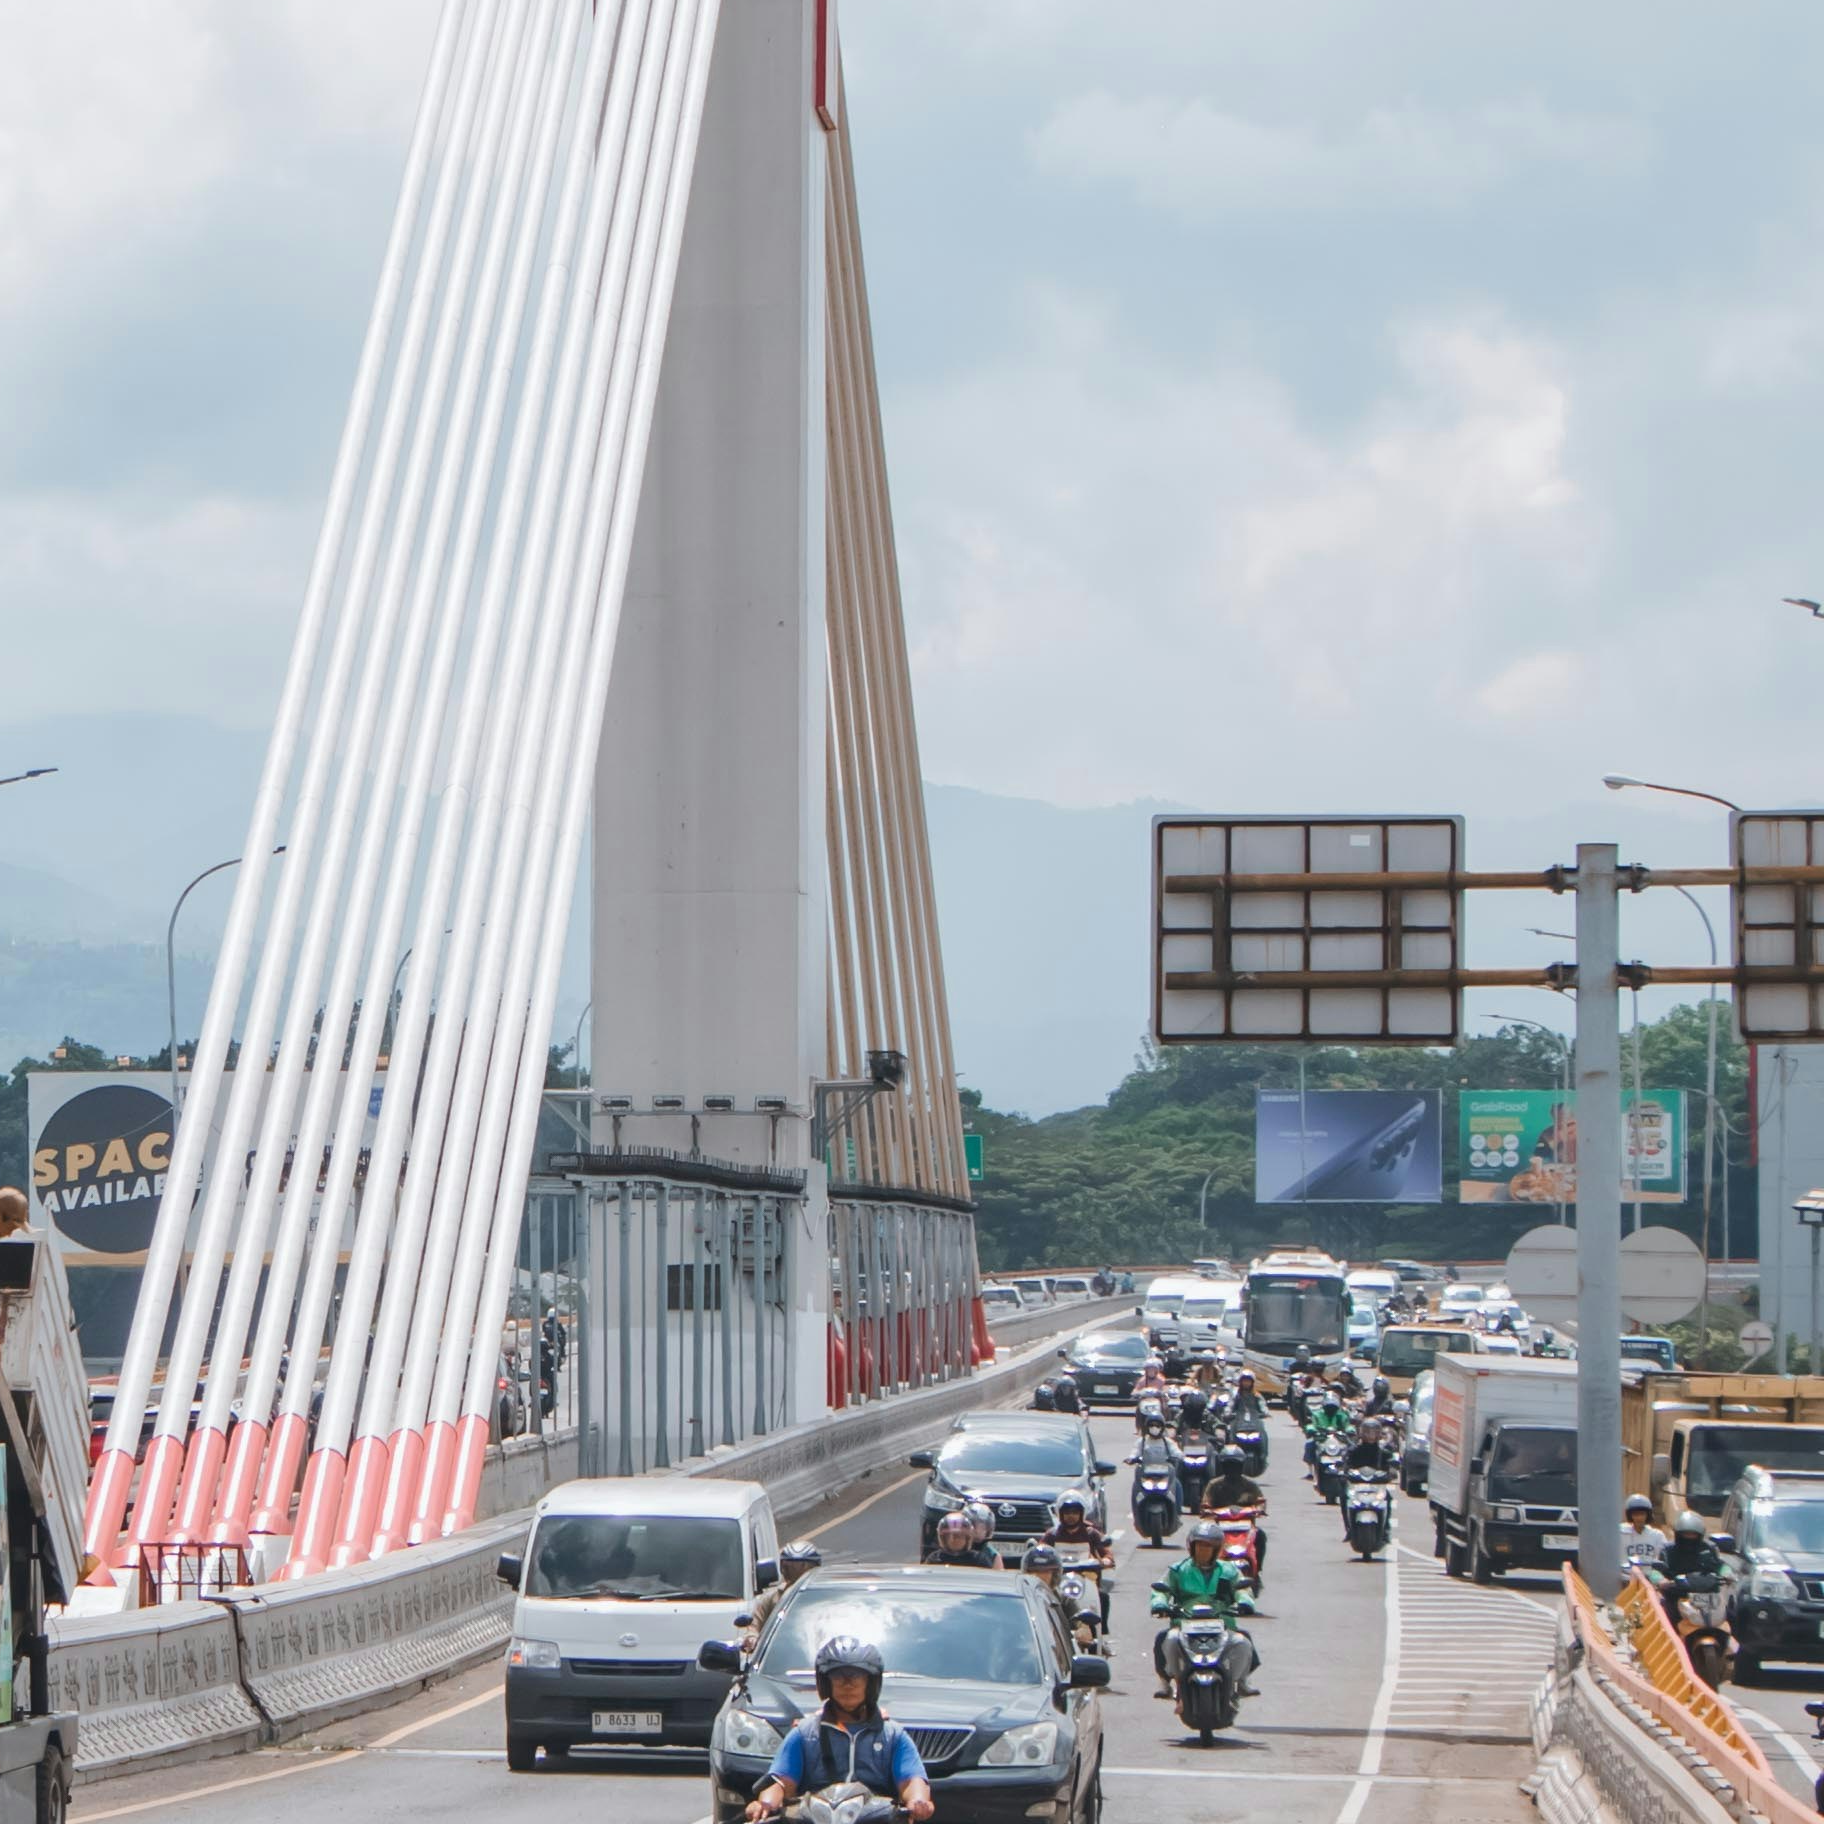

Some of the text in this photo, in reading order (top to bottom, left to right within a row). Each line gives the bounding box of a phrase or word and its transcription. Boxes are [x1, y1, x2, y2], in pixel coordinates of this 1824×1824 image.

[594, 1714, 660, 1726] D 8633 UJ
